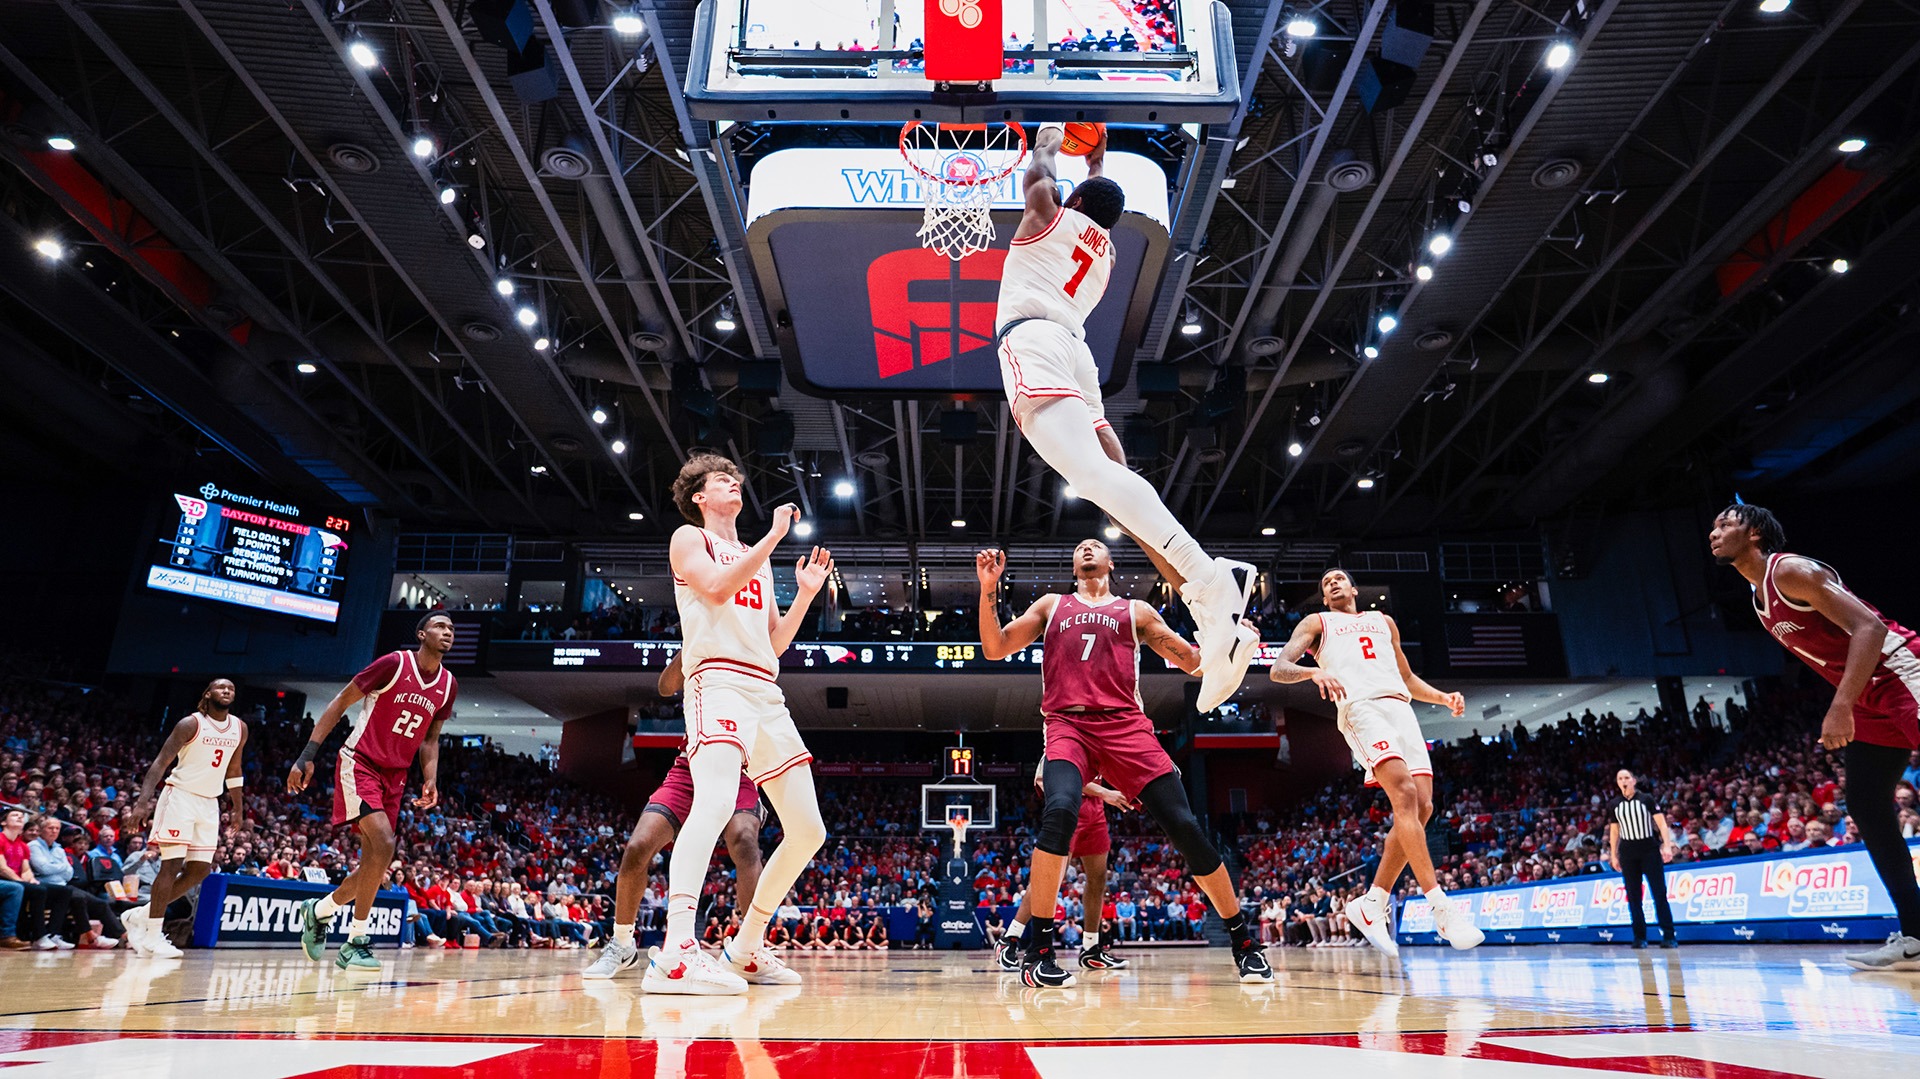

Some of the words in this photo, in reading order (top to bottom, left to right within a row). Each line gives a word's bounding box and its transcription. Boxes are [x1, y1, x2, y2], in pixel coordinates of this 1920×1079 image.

[1078, 225, 1109, 258] JONES
[1063, 244, 1094, 299] 7
[220, 488, 264, 508] Premier
[264, 499, 300, 517] Health
[220, 506, 268, 526] DAYTON
[268, 517, 311, 536] FLYERS
[325, 515, 350, 532] 2:27
[233, 526, 258, 540] FIELD
[258, 531, 281, 545] GOAL
[281, 537, 291, 547] %
[237, 537, 245, 546] 3
[245, 539, 272, 552] POINT
[272, 544, 280, 554] %
[223, 555, 248, 569] FREE
[247, 560, 285, 577] THROWS
[232, 547, 281, 565] REBOUNDS
[225, 566, 279, 585] TURNOVERS
[734, 578, 763, 611] 29
[1060, 616, 1073, 634] NC
[1074, 612, 1120, 635] CENTRAL
[565, 648, 601, 657] CENTRAL
[886, 651, 894, 662] 3
[901, 651, 909, 662] 4
[937, 645, 975, 660] 8:15
[1017, 651, 1026, 662] 4
[1080, 633, 1097, 661] 7
[1358, 636, 1377, 660] 2
[553, 657, 585, 665] DAYTON
[804, 658, 814, 667] 10
[393, 692, 408, 704] NC
[407, 692, 437, 717] CENTRAL
[391, 709, 424, 739] 22
[202, 736, 238, 748] DAYTON
[211, 748, 224, 769] 3
[954, 758, 970, 774] 17
[307, 867, 326, 880] WHIO
[1763, 865, 1848, 893] Logan
[220, 895, 304, 934] DAYTO
[327, 904, 403, 936] FLERS
